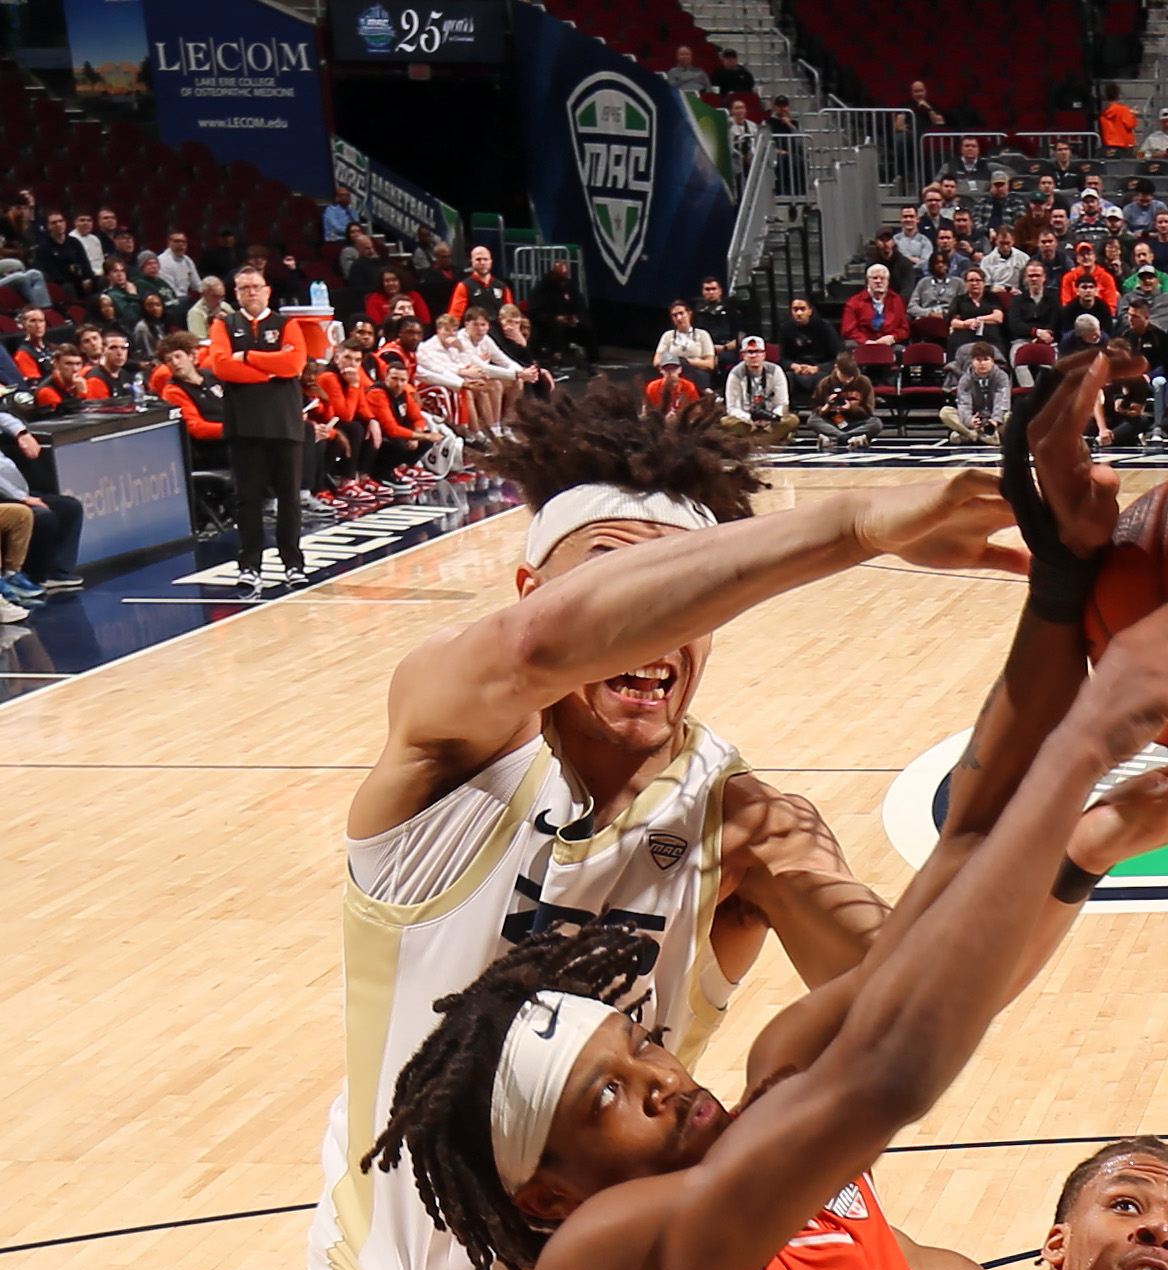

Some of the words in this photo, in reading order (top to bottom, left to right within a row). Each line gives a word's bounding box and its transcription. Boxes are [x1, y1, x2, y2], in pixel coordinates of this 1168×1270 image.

[395, 9, 443, 53] 25
[195, 77, 217, 87] LAKE
[239, 77, 276, 87] COLLEGE
[253, 88, 295, 98] MEDICINE
[198, 117, 288, 129] www.LECOM.edu
[583, 142, 651, 192] MAC
[119, 466, 172, 509] Union
